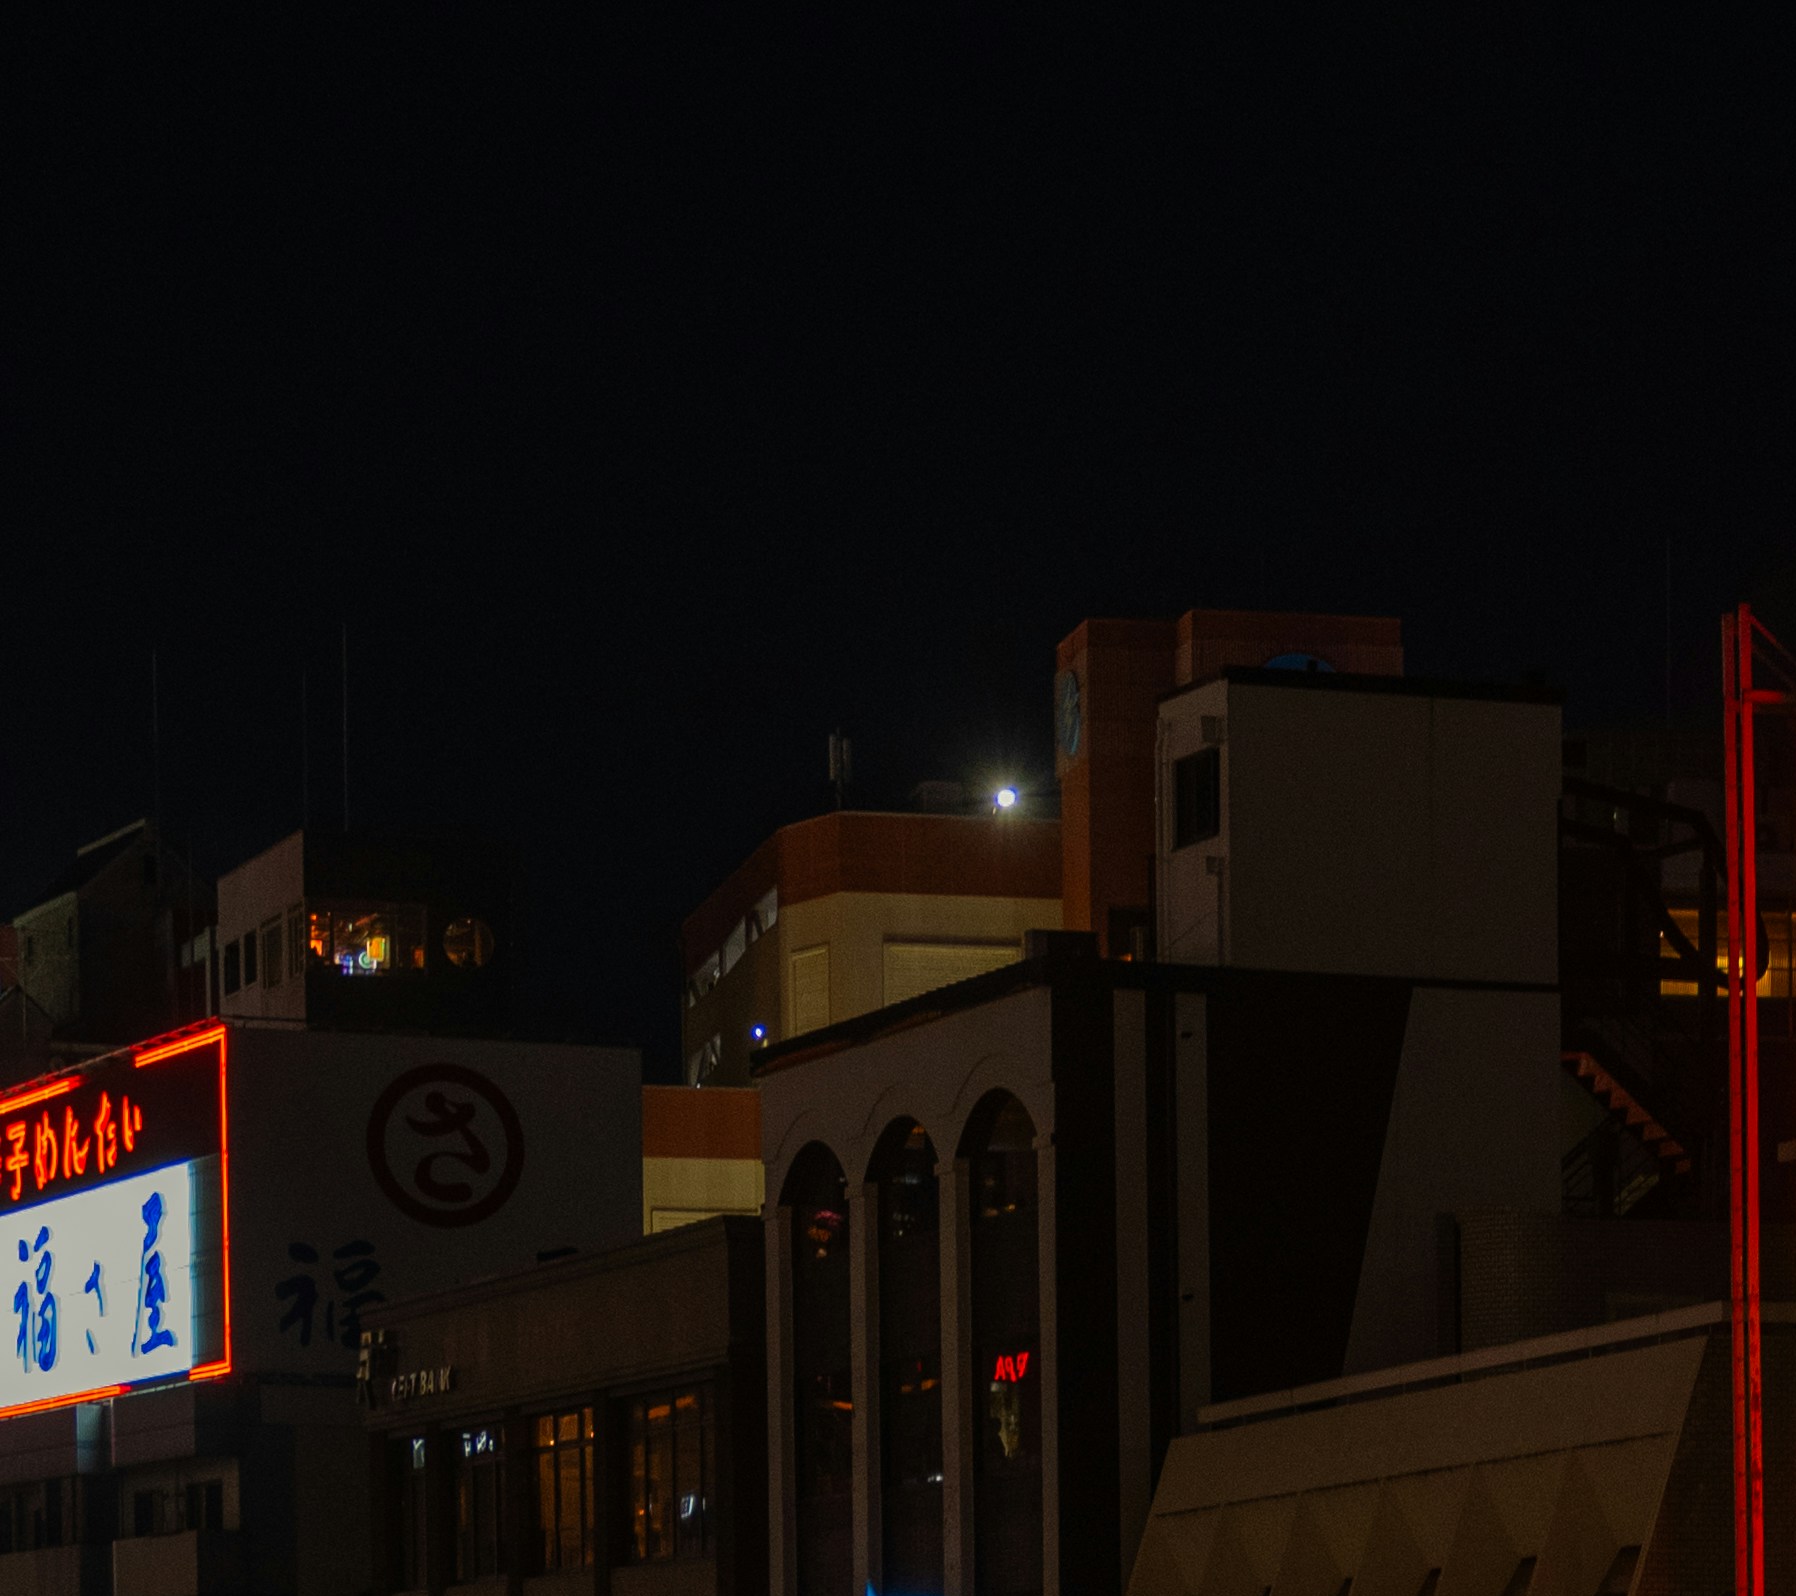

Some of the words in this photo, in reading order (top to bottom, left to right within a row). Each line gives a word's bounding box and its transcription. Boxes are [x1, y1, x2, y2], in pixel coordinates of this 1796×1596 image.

[0, 1091, 143, 1201] 子めんたい
